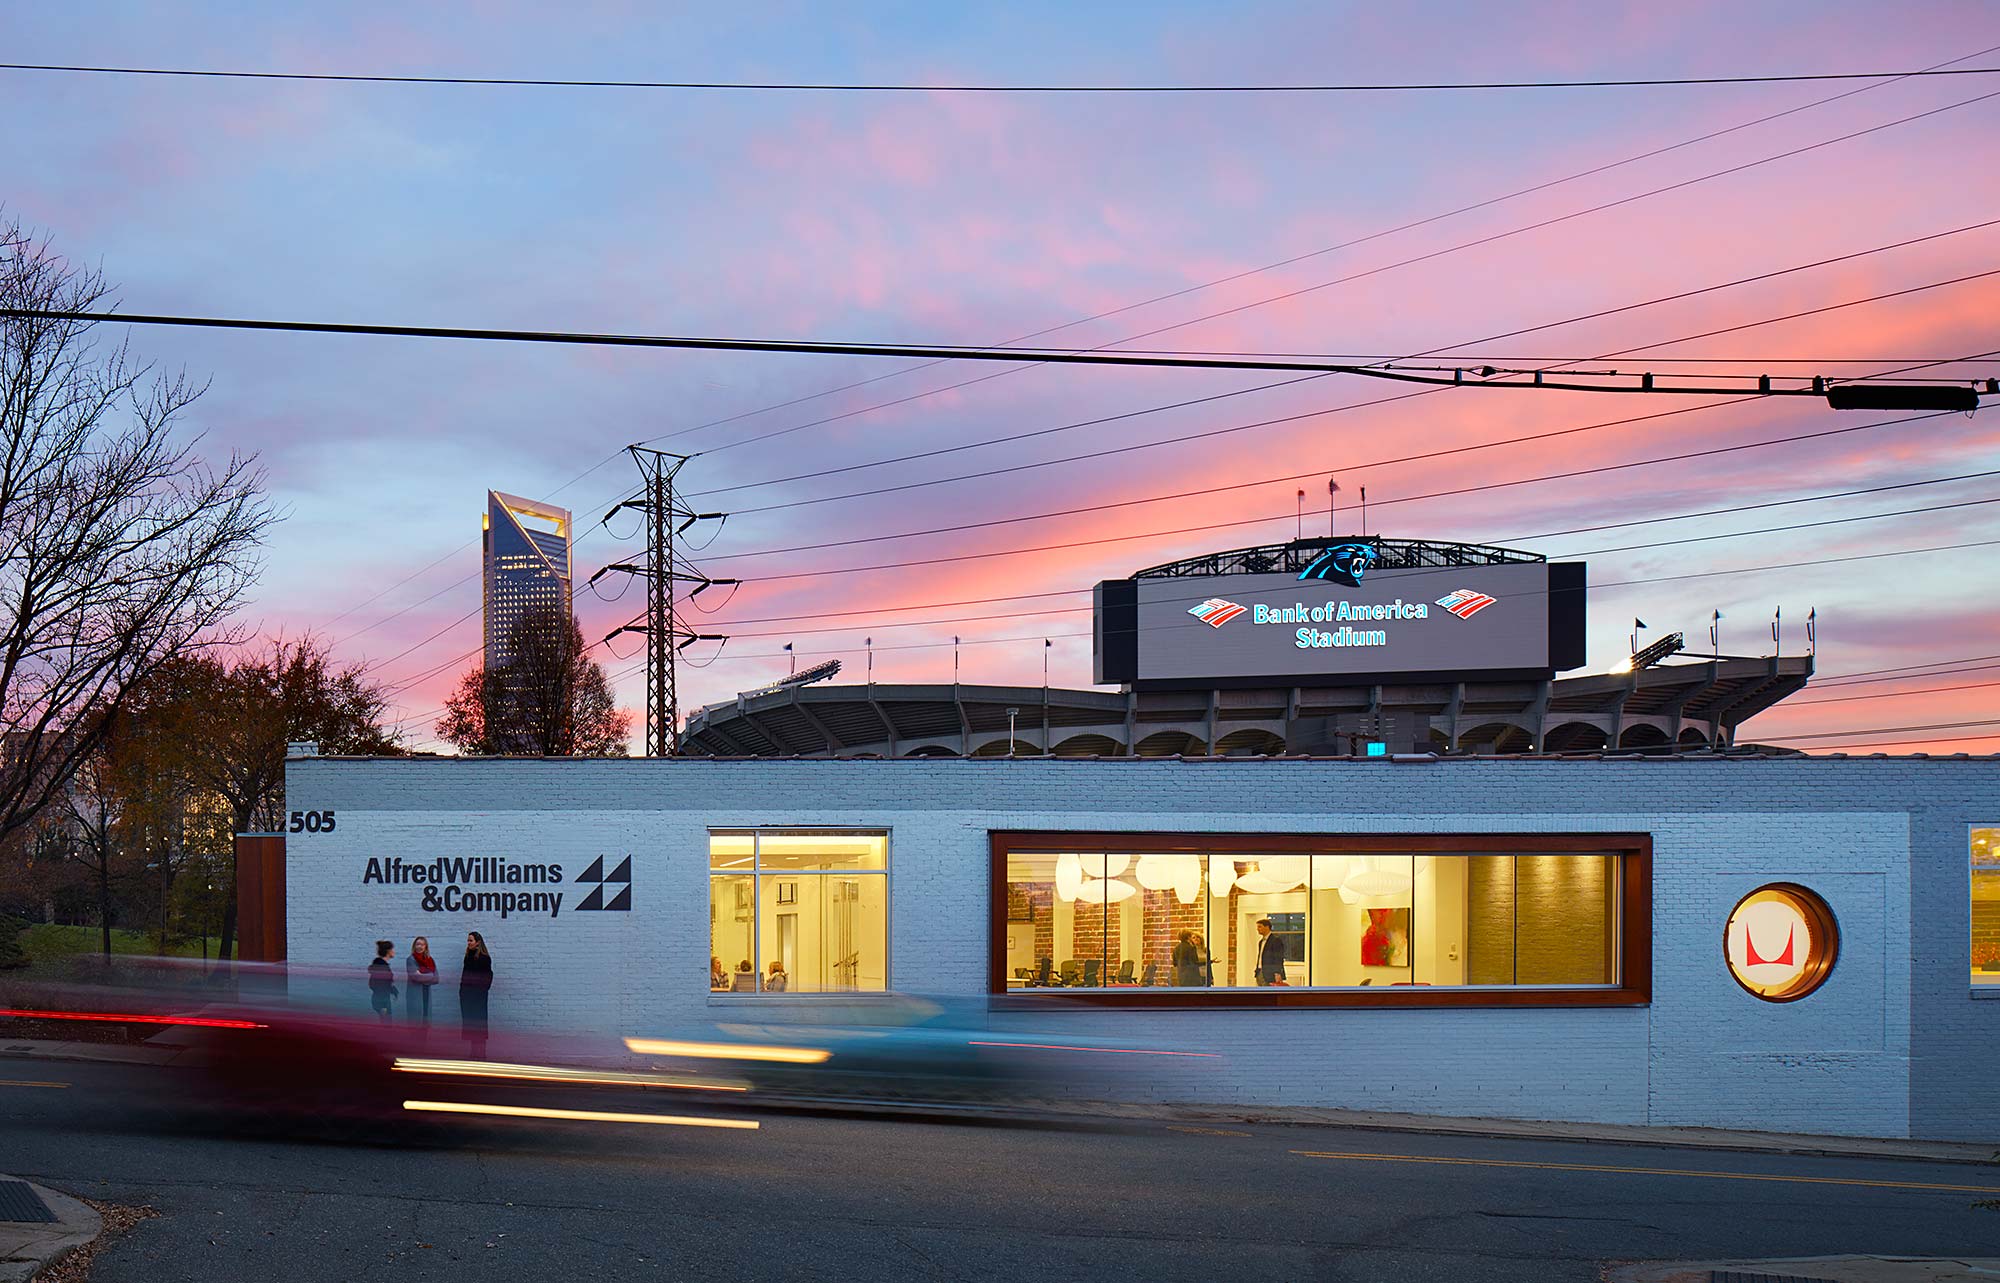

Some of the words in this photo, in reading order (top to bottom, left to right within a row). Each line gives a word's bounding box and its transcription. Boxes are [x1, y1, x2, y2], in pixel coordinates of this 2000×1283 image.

[1254, 602, 1310, 624] Bank
[1310, 601, 1335, 622] of
[1335, 599, 1428, 621] America
[1295, 627, 1386, 648] Stadium
[289, 810, 337, 834] 505
[362, 857, 563, 884] AlfredWilliams
[421, 885, 563, 918] &Company
